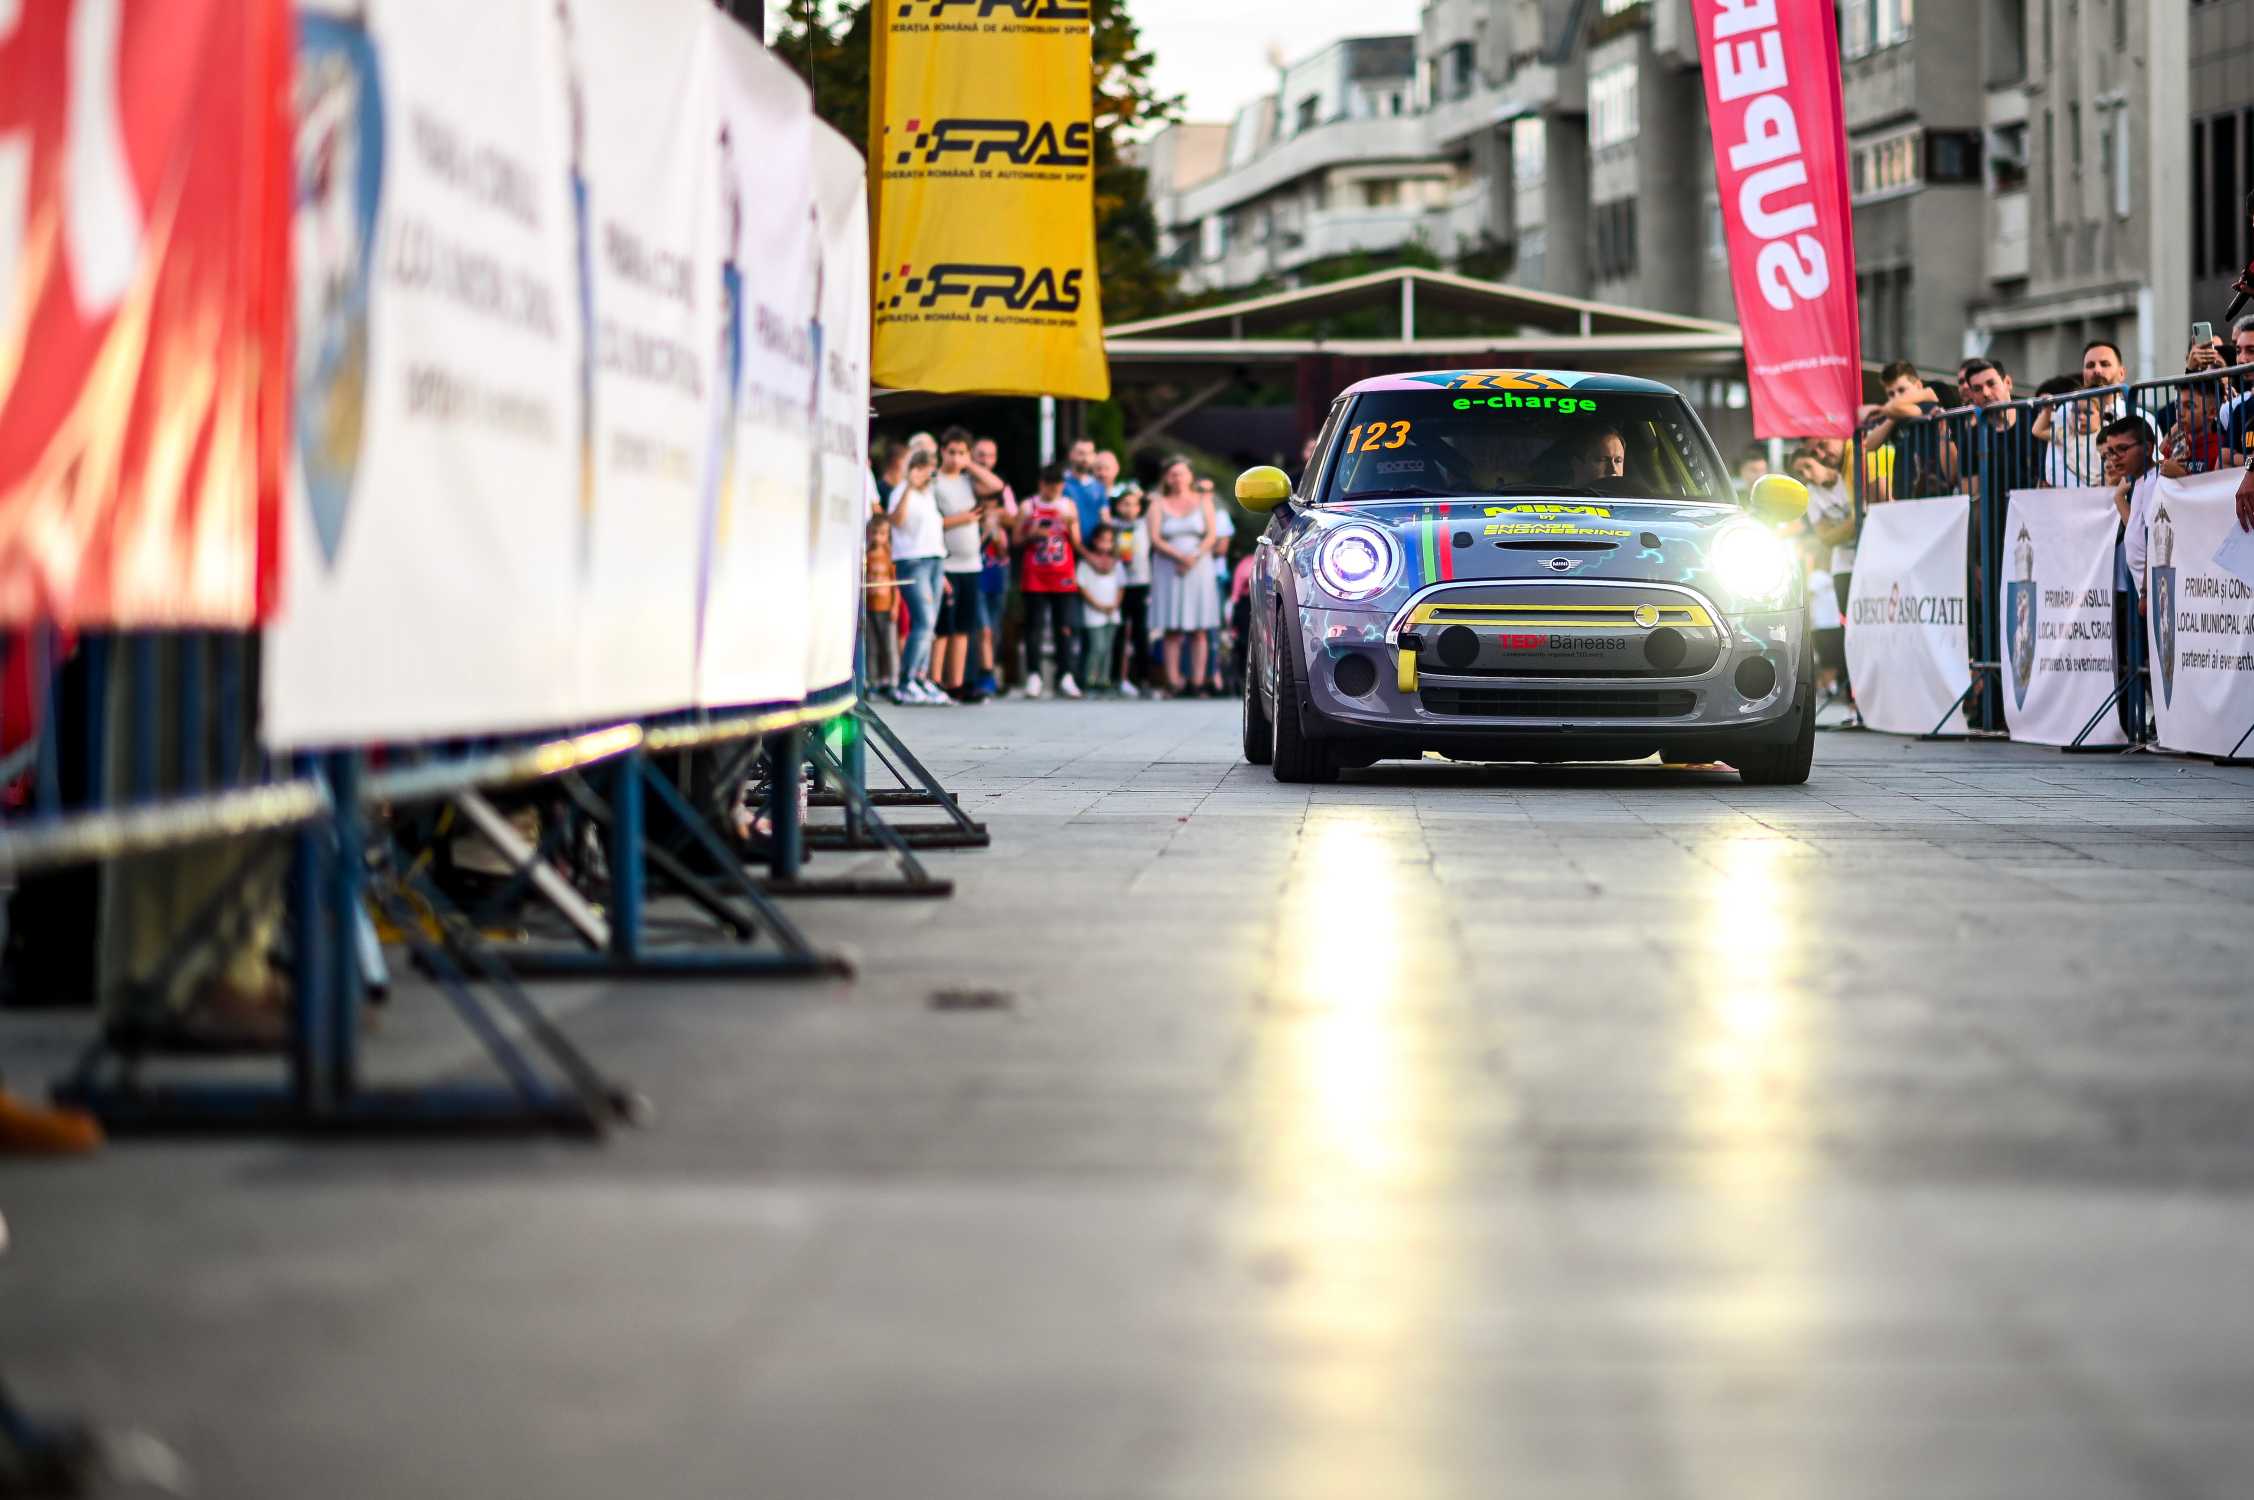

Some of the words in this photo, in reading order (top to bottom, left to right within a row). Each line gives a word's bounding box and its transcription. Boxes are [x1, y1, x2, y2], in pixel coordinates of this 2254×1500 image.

[982, 24, 995, 33] DE
[924, 118, 1089, 166] FRAS
[979, 170, 992, 178] DE
[918, 263, 1082, 312] FRAS
[1453, 392, 1597, 413] e-charge
[1346, 420, 1411, 455] 123
[1538, 513, 1556, 521] by
[1483, 528, 1633, 537] ENGINEERING
[2200, 613, 2239, 634] MUNICIPAL
